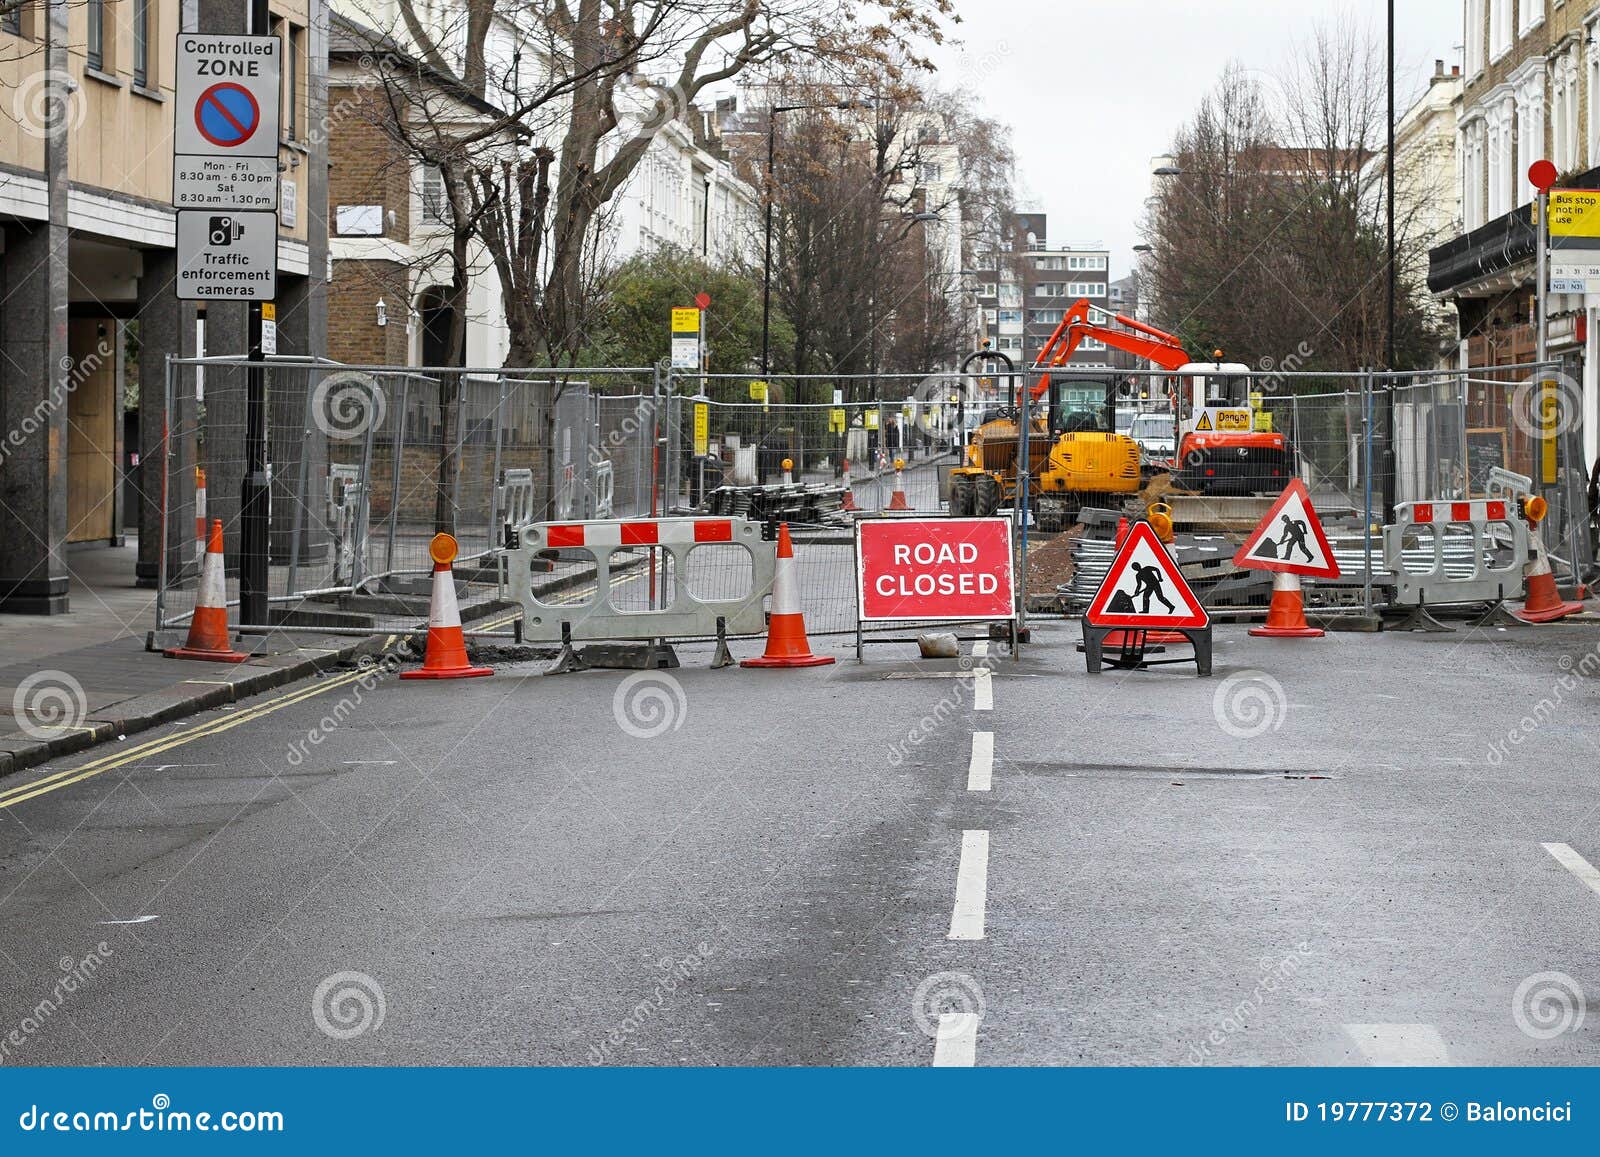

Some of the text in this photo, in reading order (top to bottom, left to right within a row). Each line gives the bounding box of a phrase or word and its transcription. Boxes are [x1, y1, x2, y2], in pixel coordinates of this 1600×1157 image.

[185, 40, 273, 55] Controlled
[197, 59, 259, 77] ZONE
[203, 161, 225, 171] Mon
[236, 162, 249, 171] Fri
[180, 171, 204, 181] 8.30
[206, 173, 221, 181] am
[231, 173, 255, 182] 6.30
[257, 175, 272, 184] pm
[217, 183, 235, 192] Sat
[180, 193, 205, 202] 8.30
[206, 195, 221, 203] am
[232, 194, 254, 204] 1.30
[255, 196, 271, 205] pm
[1556, 195, 1597, 206] Bus stop
[1556, 206, 1583, 214] not in
[203, 253, 249, 265] Traffic
[182, 268, 271, 280] enforcement
[197, 286, 255, 296] cameras
[1218, 412, 1248, 424] Danger
[894, 543, 978, 565] ROAD
[875, 573, 998, 596] CLOSED
